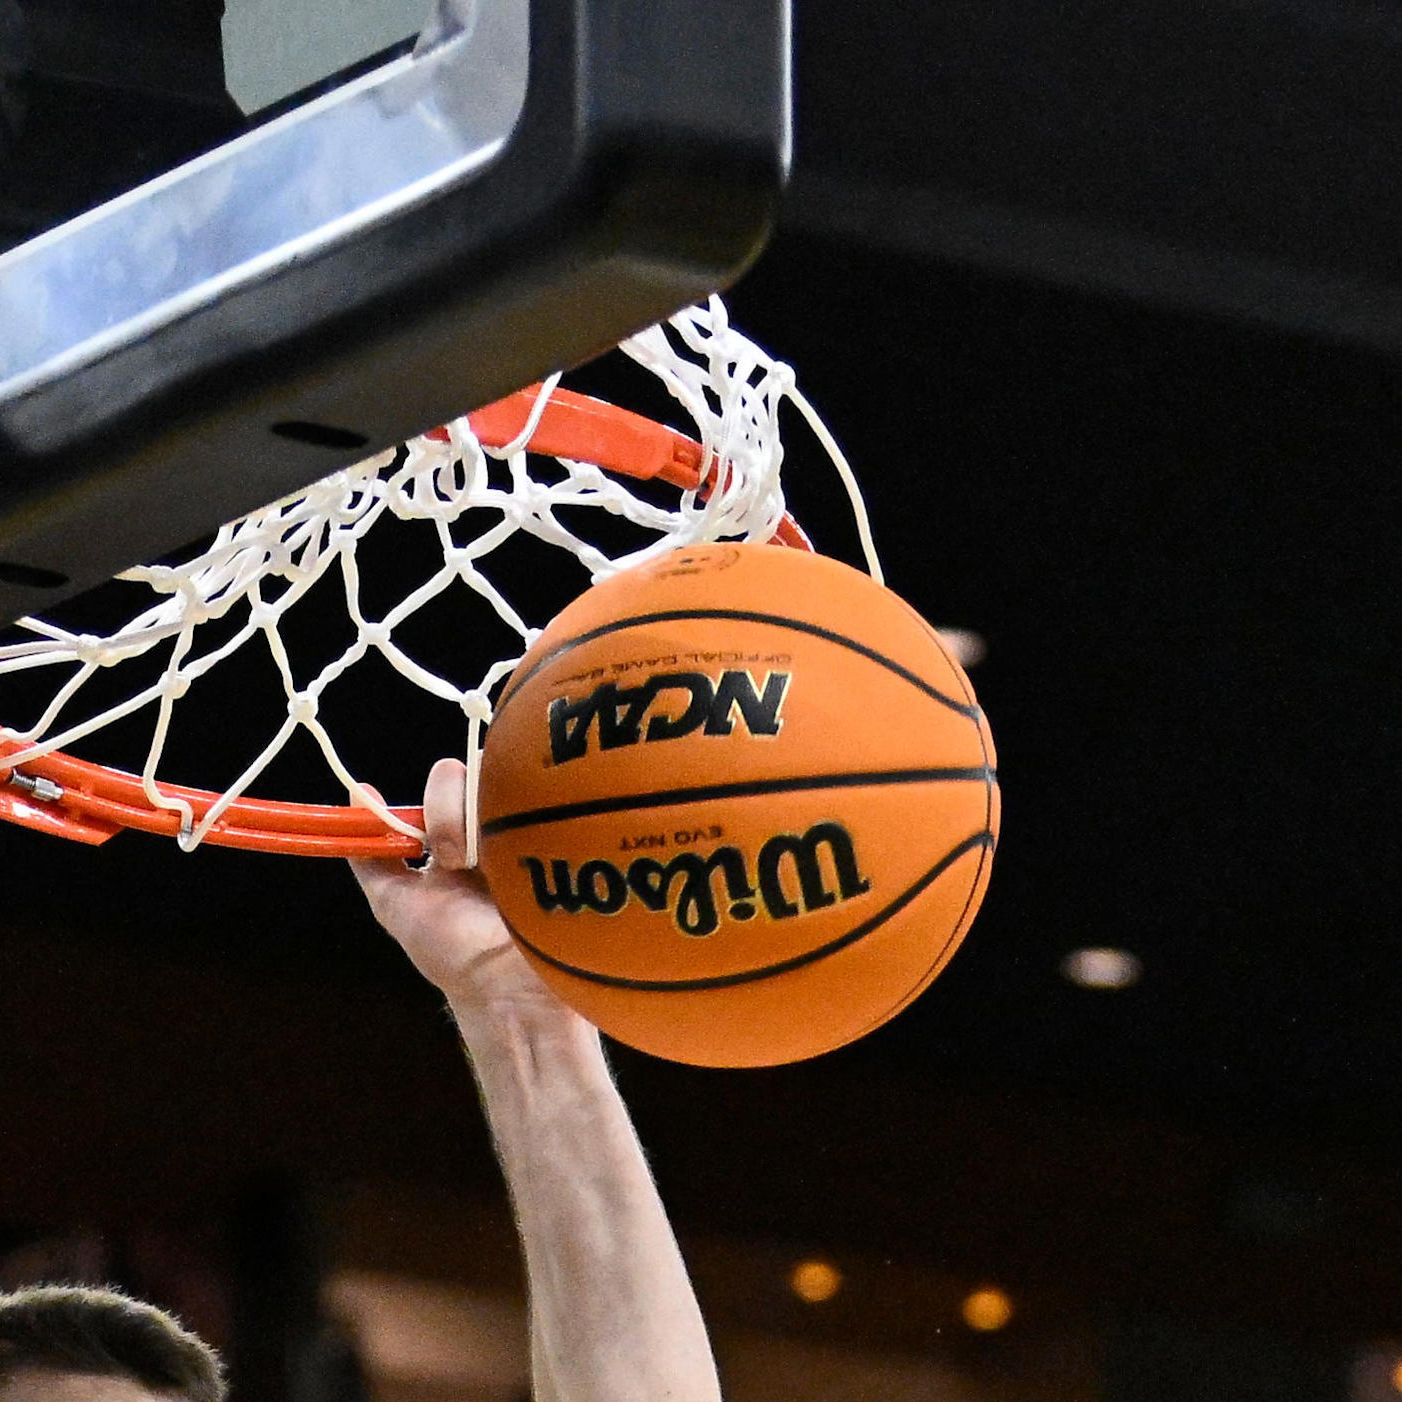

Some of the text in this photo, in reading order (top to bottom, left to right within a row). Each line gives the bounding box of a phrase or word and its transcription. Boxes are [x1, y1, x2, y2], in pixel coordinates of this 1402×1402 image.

[547, 669, 792, 766] NCAA
[518, 820, 872, 937] Wilson
[619, 825, 723, 851] EVO NXT
